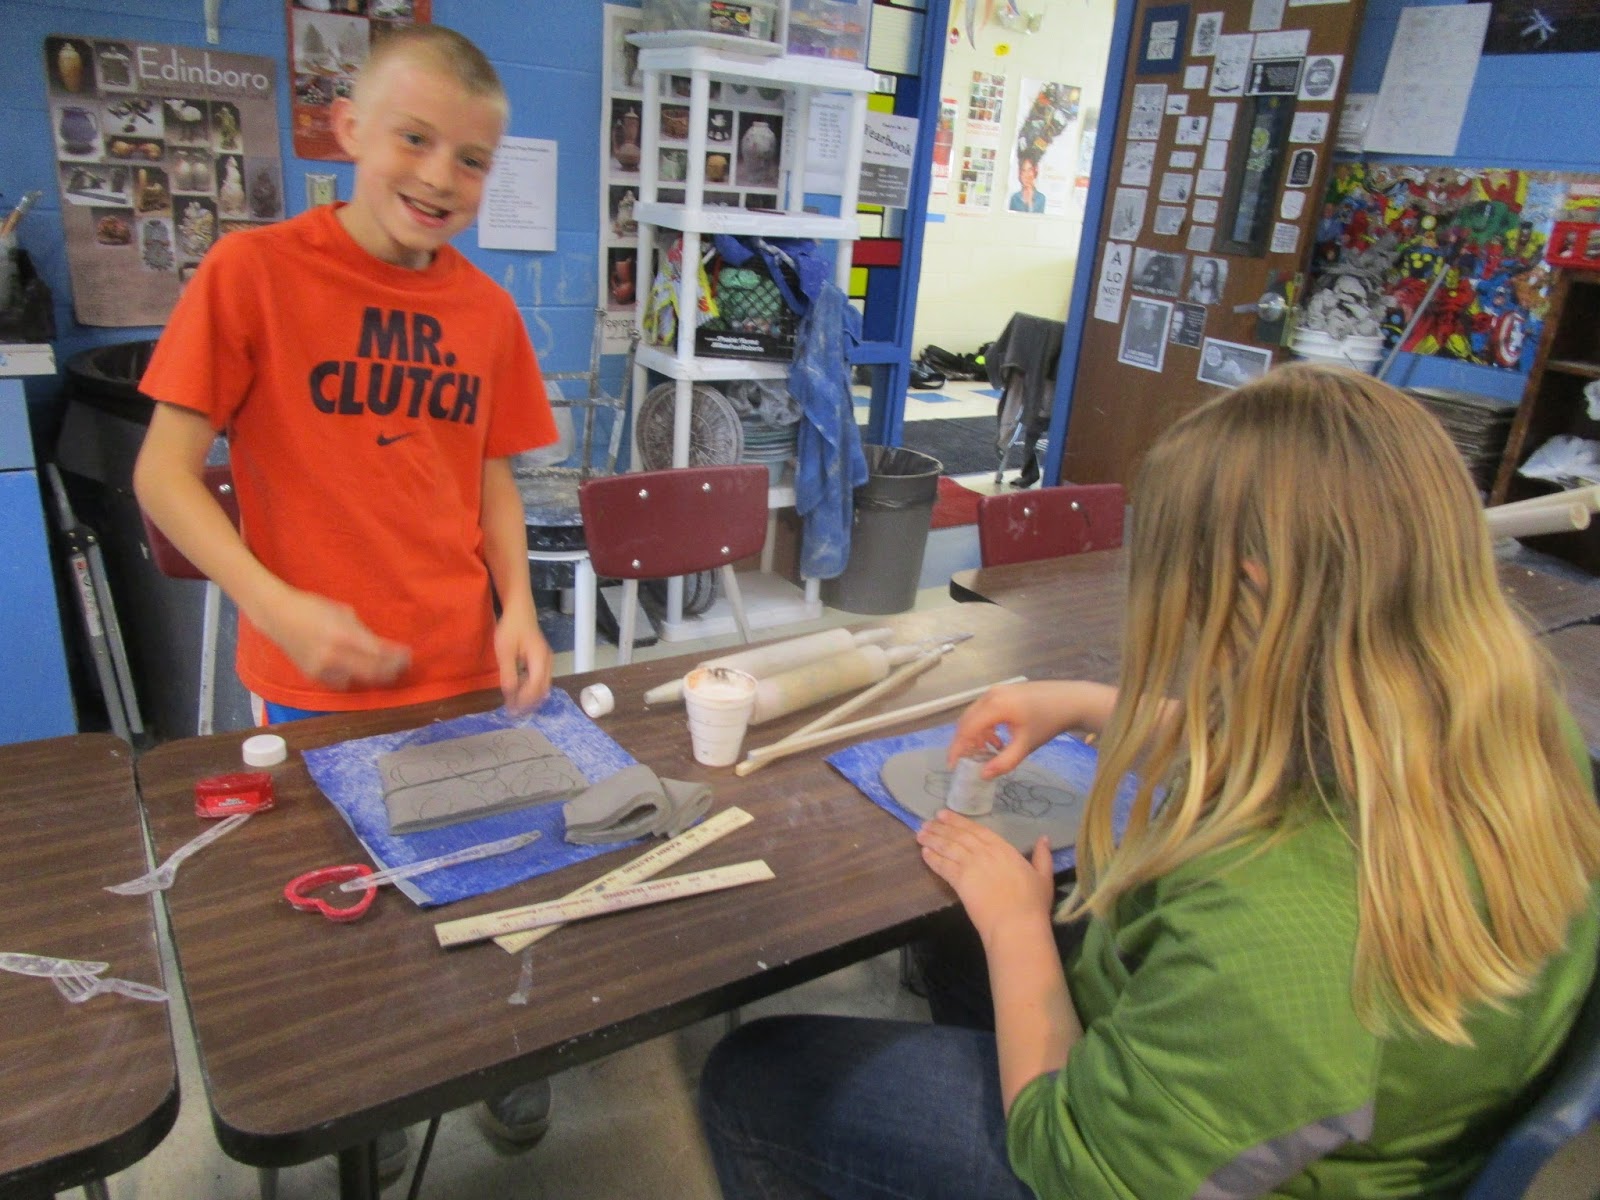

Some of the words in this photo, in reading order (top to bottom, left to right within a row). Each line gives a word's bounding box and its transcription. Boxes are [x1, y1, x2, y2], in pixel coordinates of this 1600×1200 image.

[138, 46, 269, 90] Edinboro
[1111, 250, 1122, 267] A
[357, 306, 456, 367] MR.
[309, 360, 480, 425] CLUTCH
